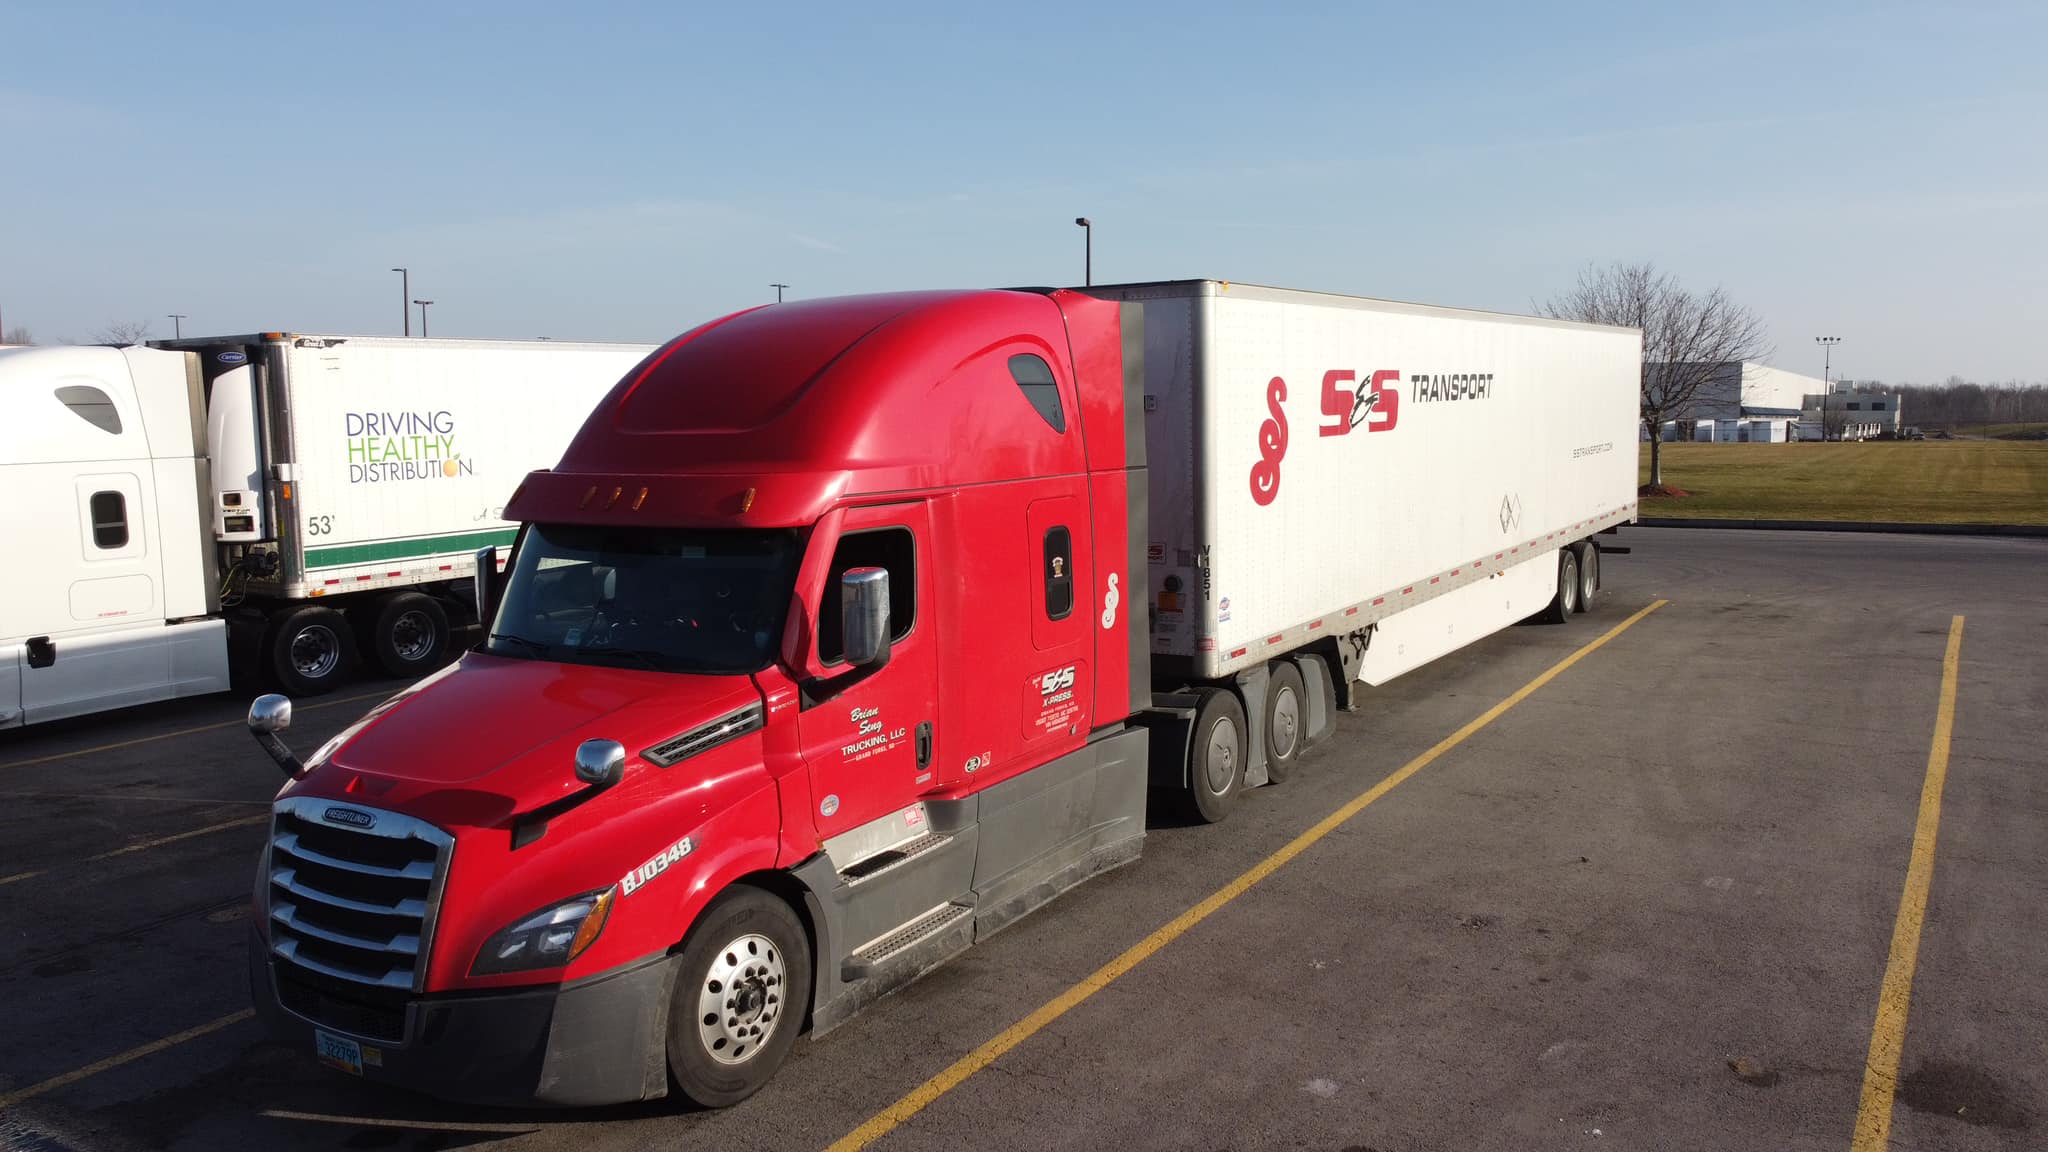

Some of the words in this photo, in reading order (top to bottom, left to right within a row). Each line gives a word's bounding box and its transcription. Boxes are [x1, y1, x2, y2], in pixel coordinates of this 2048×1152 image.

[1411, 374, 1493, 403] TRANSPORT
[346, 411, 454, 436] DRIVING
[348, 434, 454, 463] HEALTHY
[850, 706, 879, 722] Brian
[890, 727, 906, 740] LLC
[327, 808, 370, 825] FREIGHTLINER
